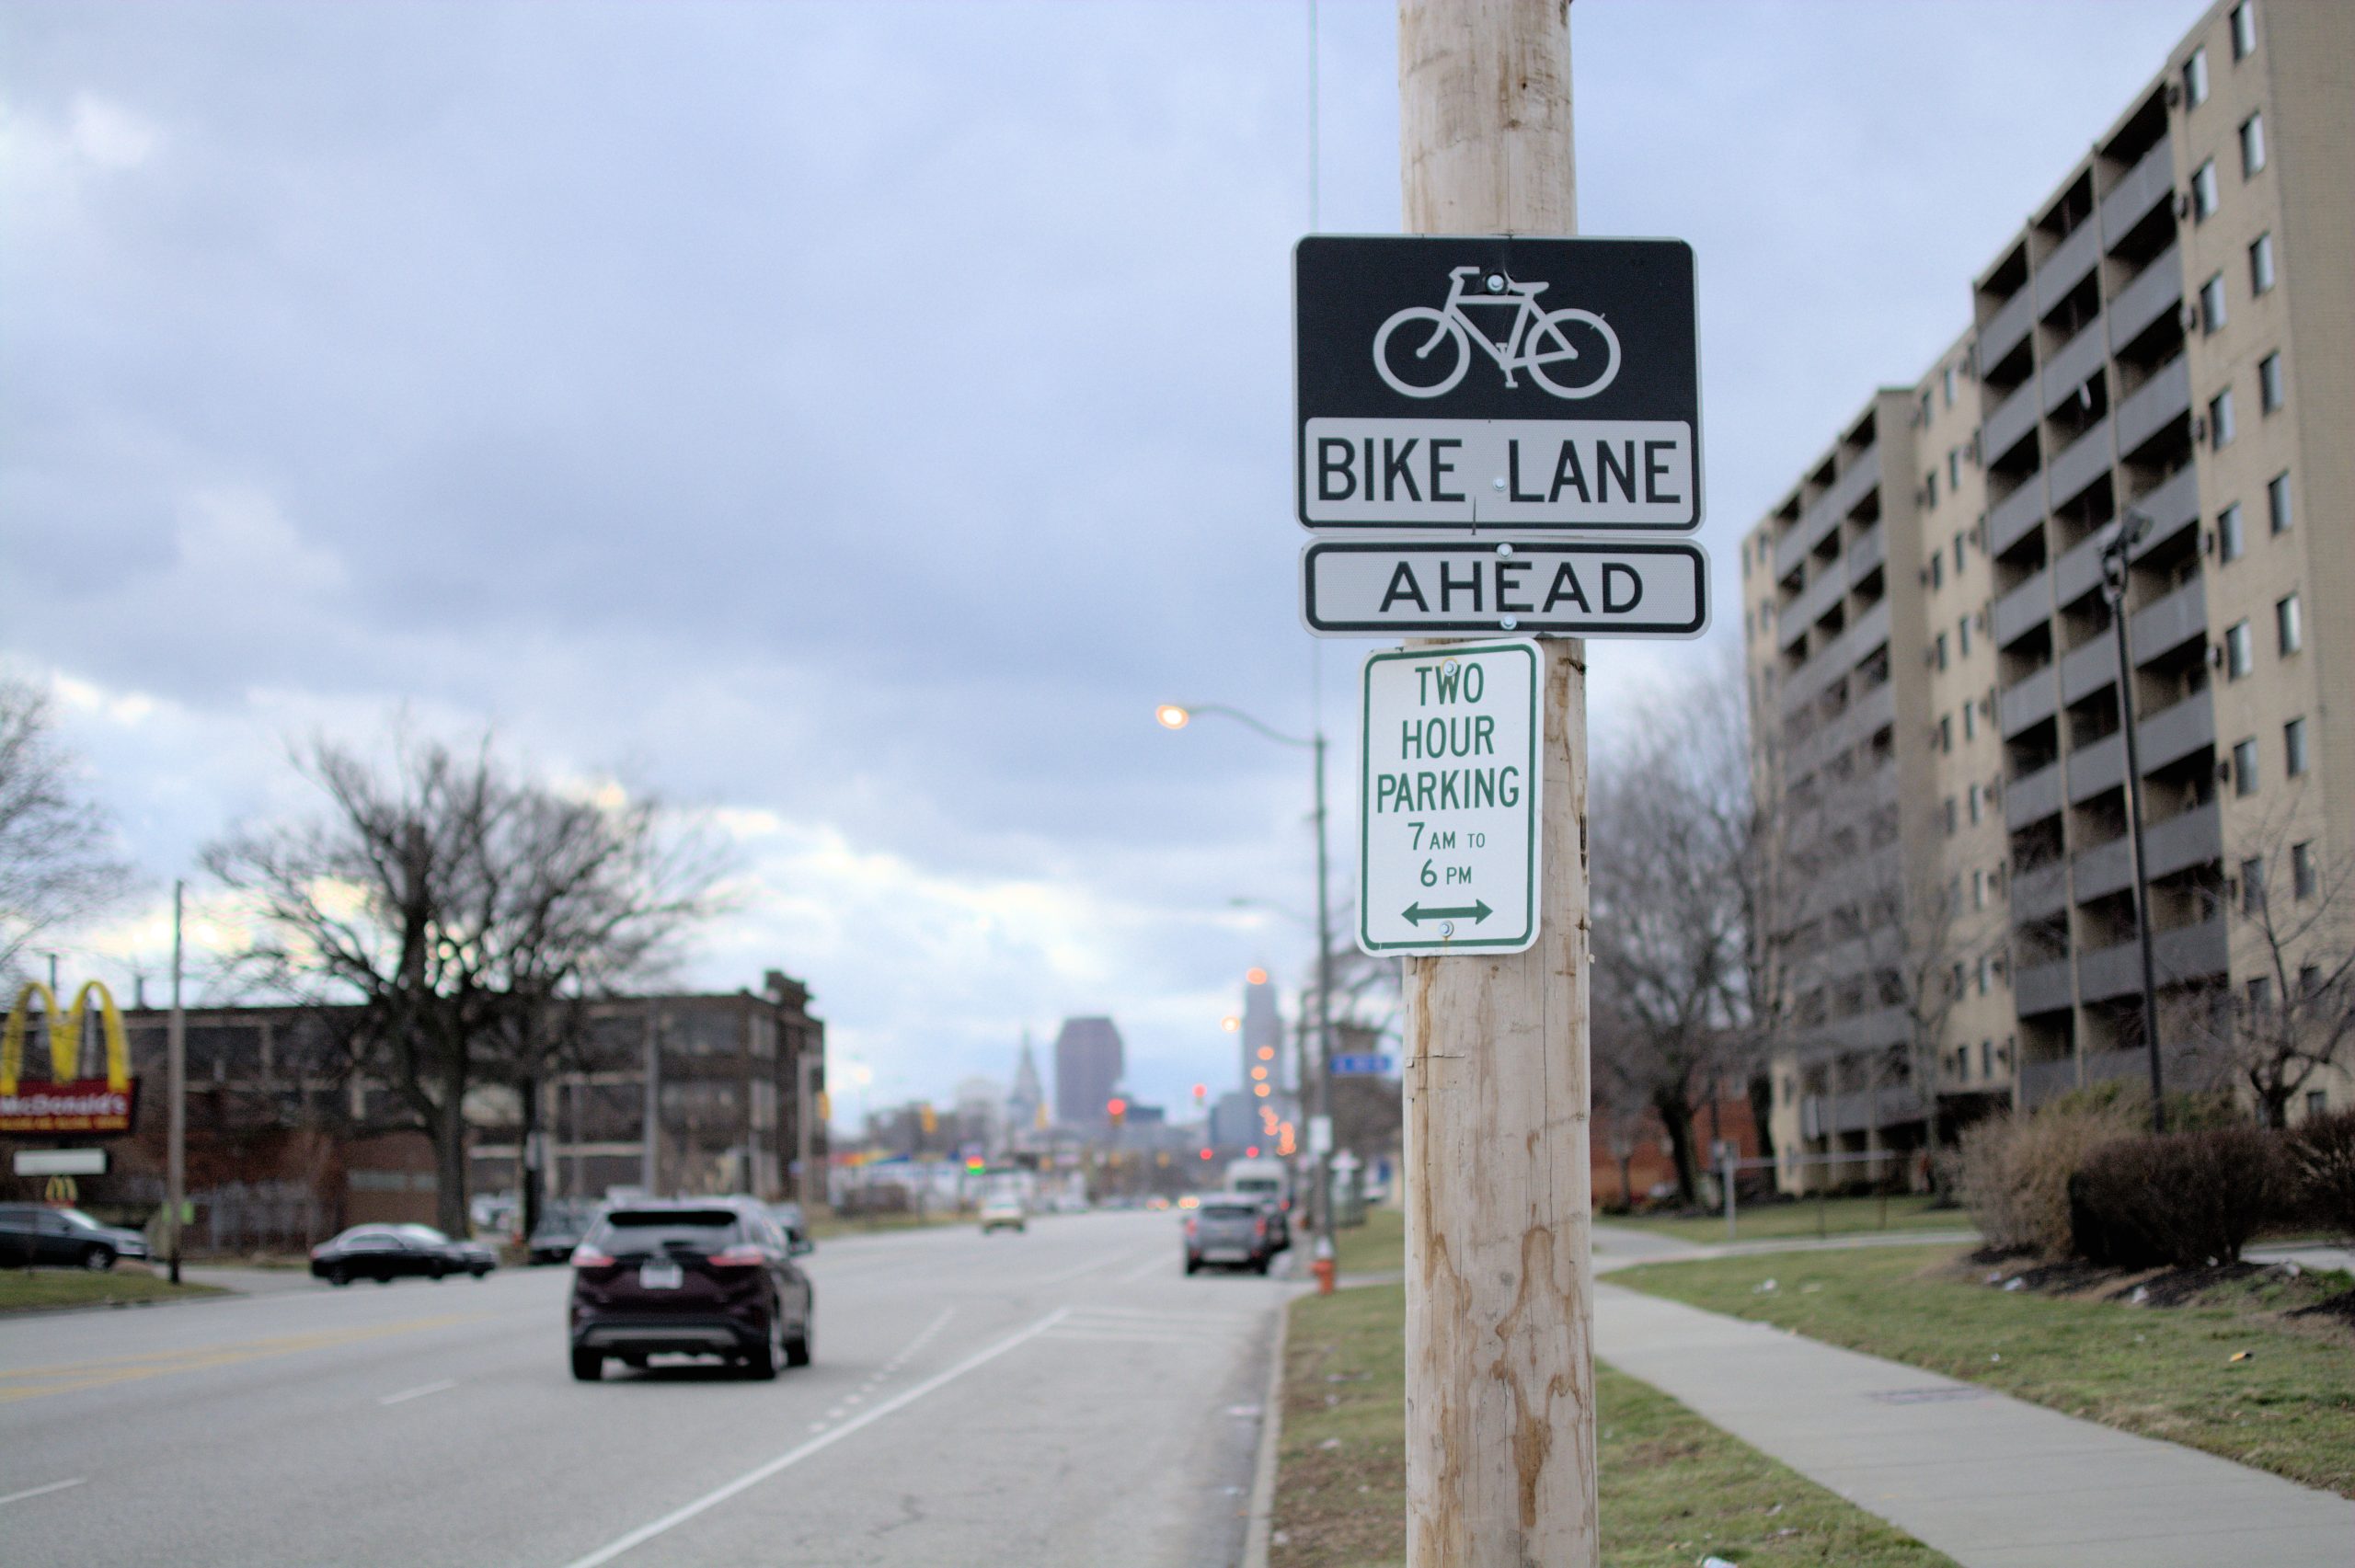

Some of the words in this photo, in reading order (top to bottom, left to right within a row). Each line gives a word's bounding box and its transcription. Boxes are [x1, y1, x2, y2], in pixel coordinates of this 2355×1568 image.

[1317, 437, 1466, 502] BIKE
[1509, 439, 1682, 504] LANE
[1378, 560, 1644, 614] AHEAD
[1414, 662, 1484, 706] TWO
[1402, 715, 1495, 760] HOUR
[1377, 765, 1520, 814] PARKING
[1407, 821, 1425, 851] 7
[1429, 830, 1456, 850] AM
[1467, 832, 1486, 848] TO
[1420, 858, 1438, 887] 6
[1446, 866, 1472, 885] PM
